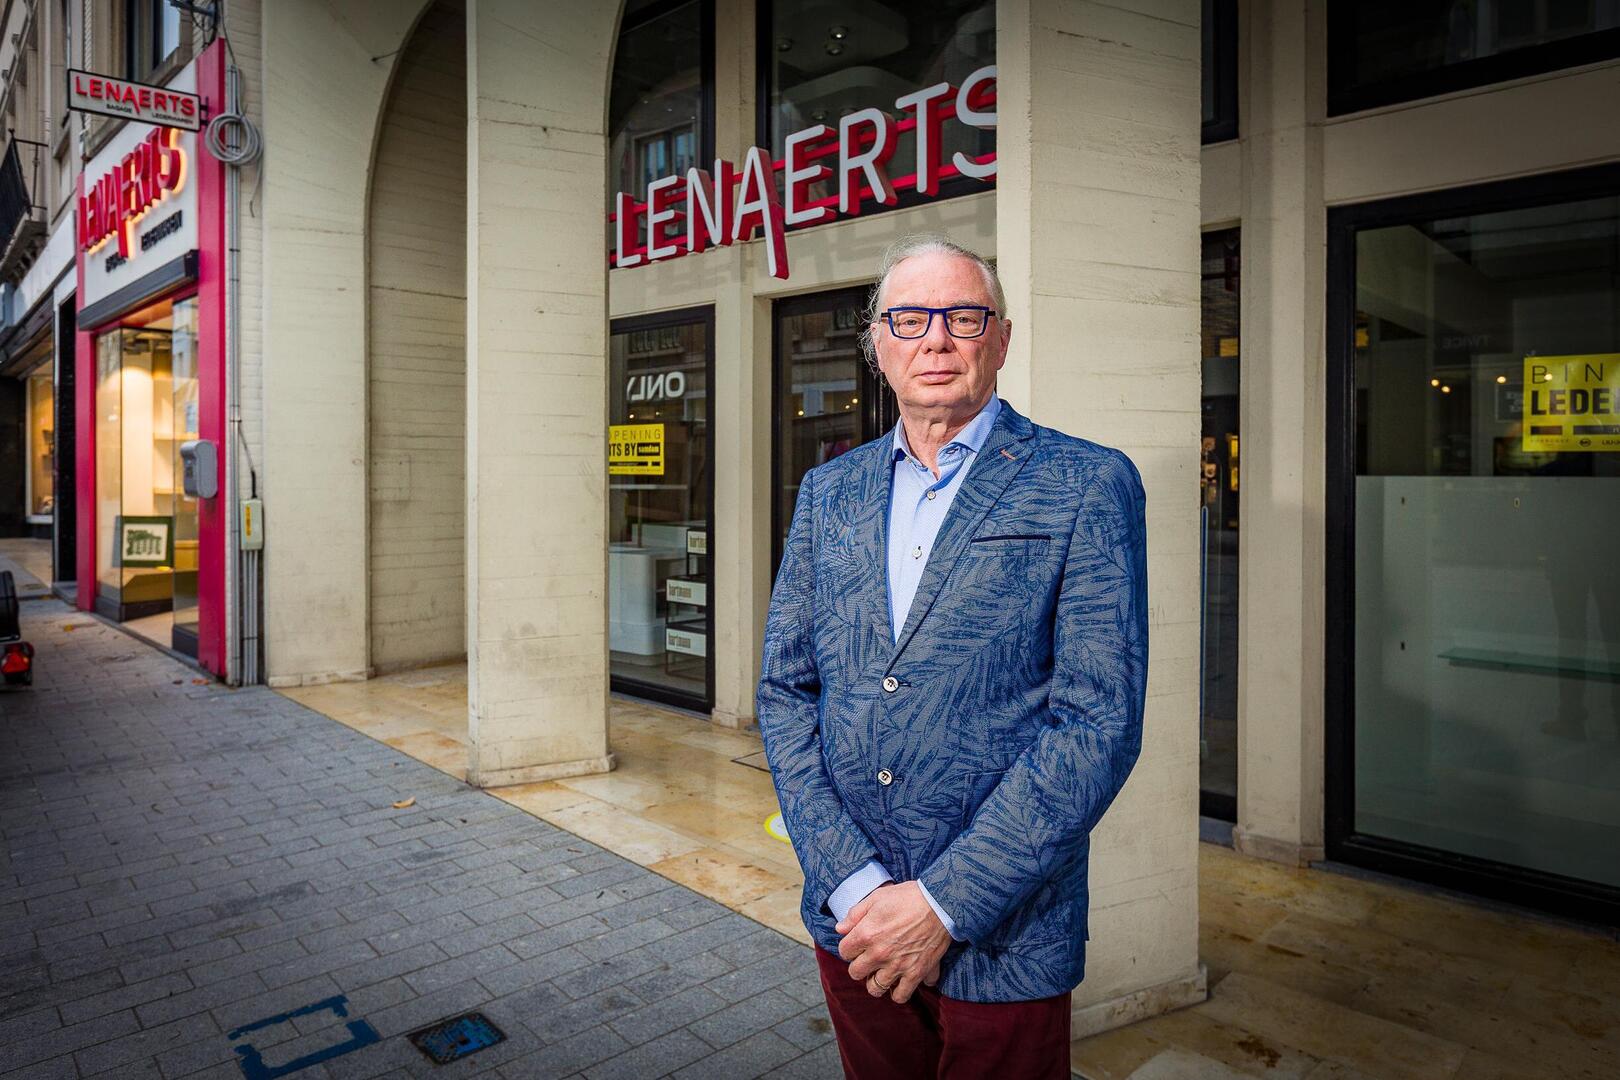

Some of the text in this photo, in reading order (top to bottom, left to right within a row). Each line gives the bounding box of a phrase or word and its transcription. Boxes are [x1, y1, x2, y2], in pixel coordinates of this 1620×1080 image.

[76, 76, 195, 116] LENAERTS
[615, 64, 997, 280] LENAERTS
[624, 443, 636, 456] BY
